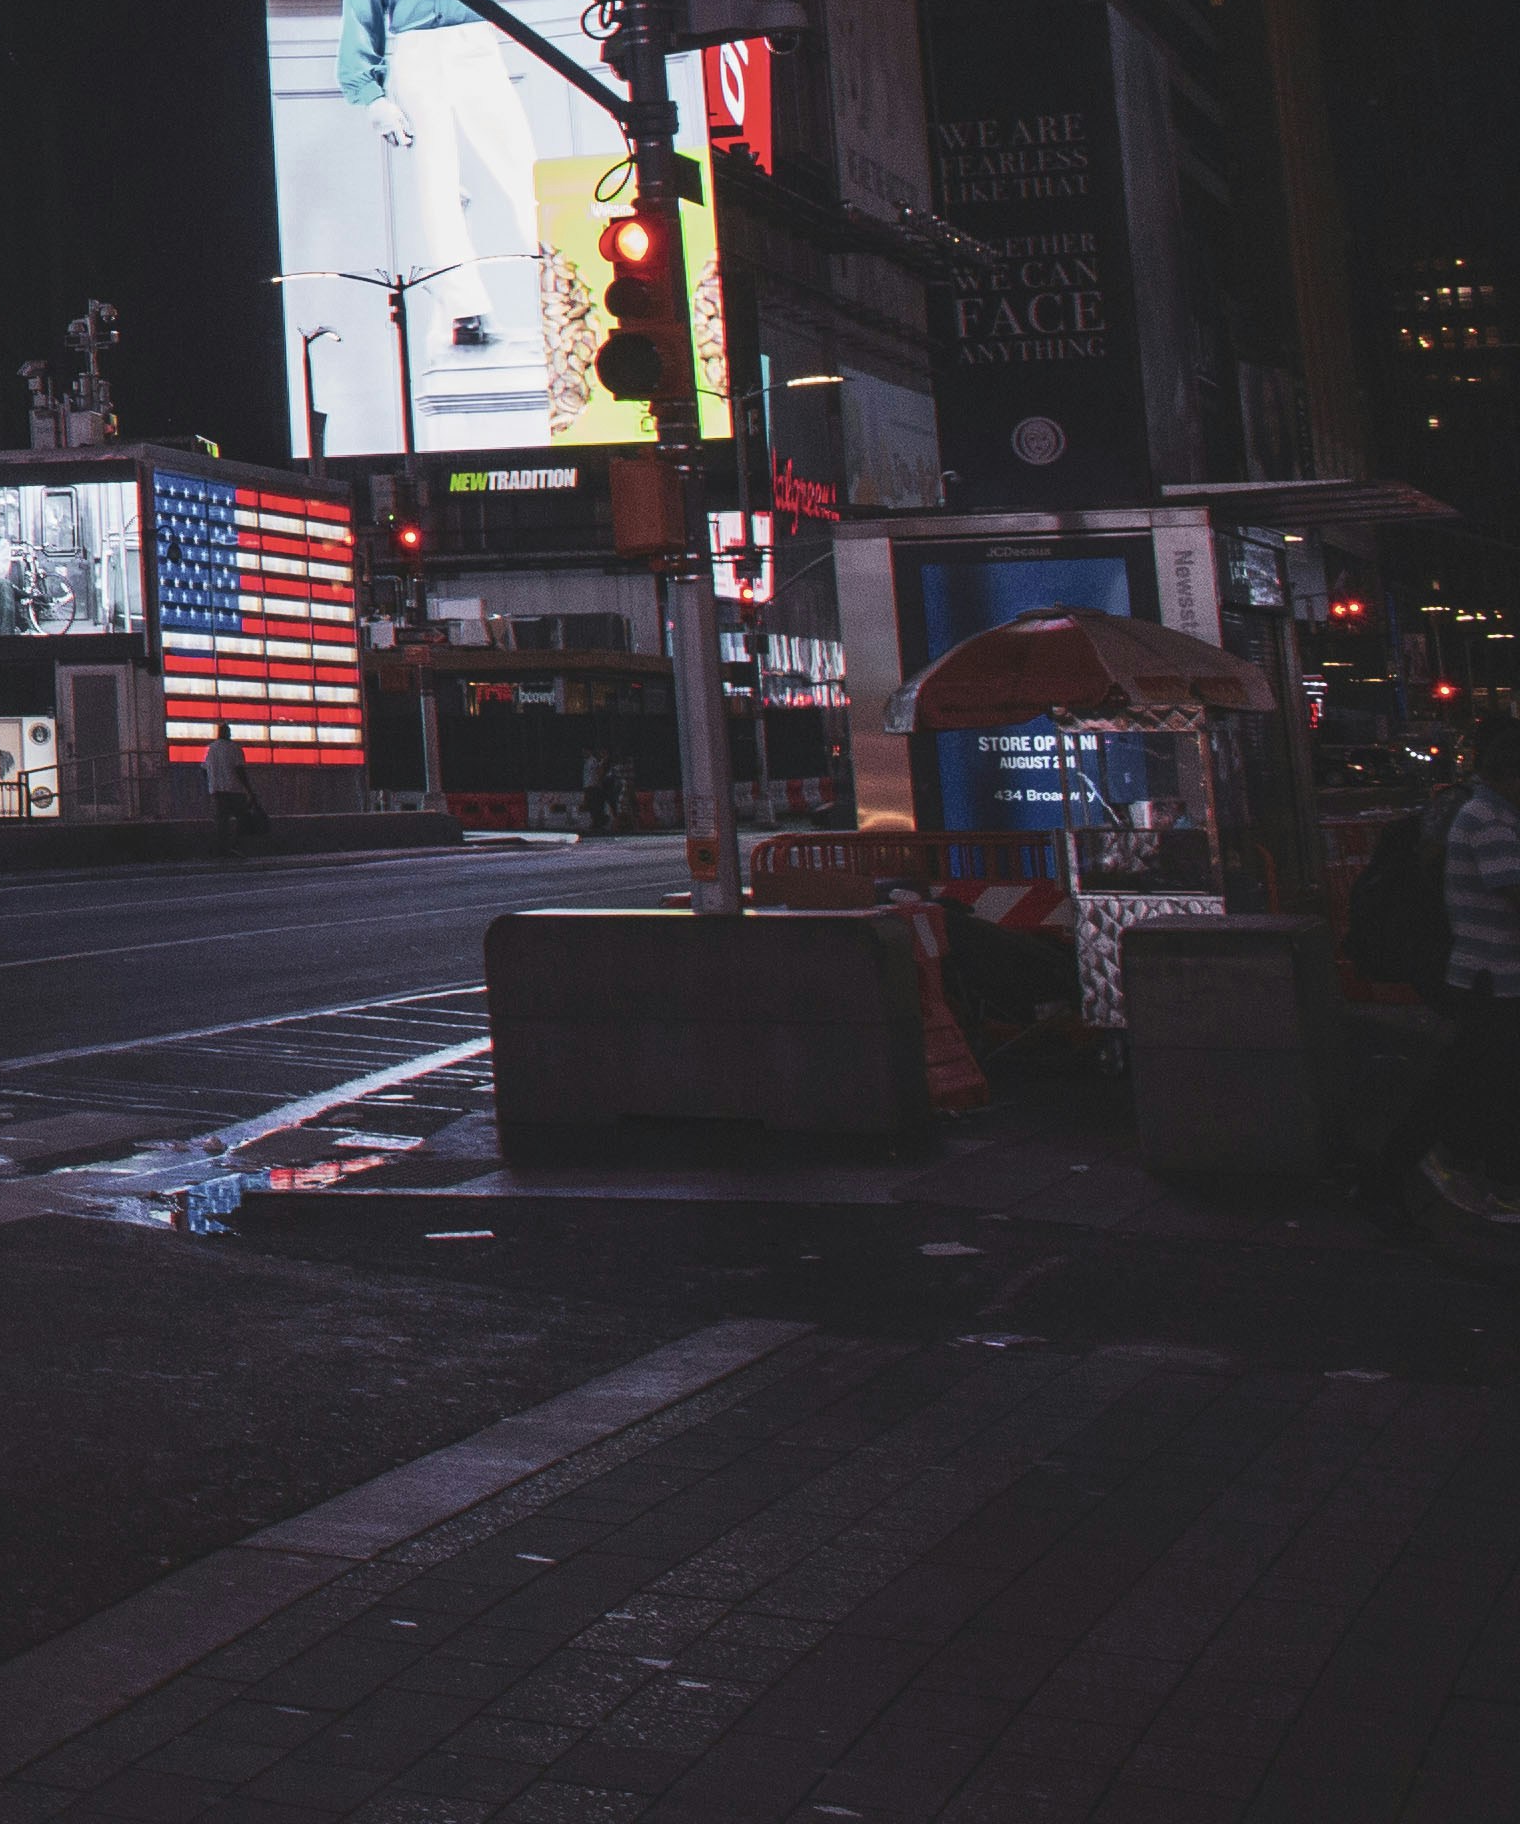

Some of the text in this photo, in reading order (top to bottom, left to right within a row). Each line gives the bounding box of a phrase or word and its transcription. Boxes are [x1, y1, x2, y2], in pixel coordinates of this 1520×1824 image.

[939, 112, 1086, 150] WE ARE
[939, 148, 1090, 179] FEARLESS
[942, 174, 1091, 205] LIKE THAT
[953, 258, 1099, 292] WE CAN
[955, 290, 1108, 339] FACE
[960, 335, 1107, 365] ANYTHING
[978, 735, 1031, 752] STORE
[999, 755, 1052, 769] AUGUST
[994, 789, 1024, 801] 434
